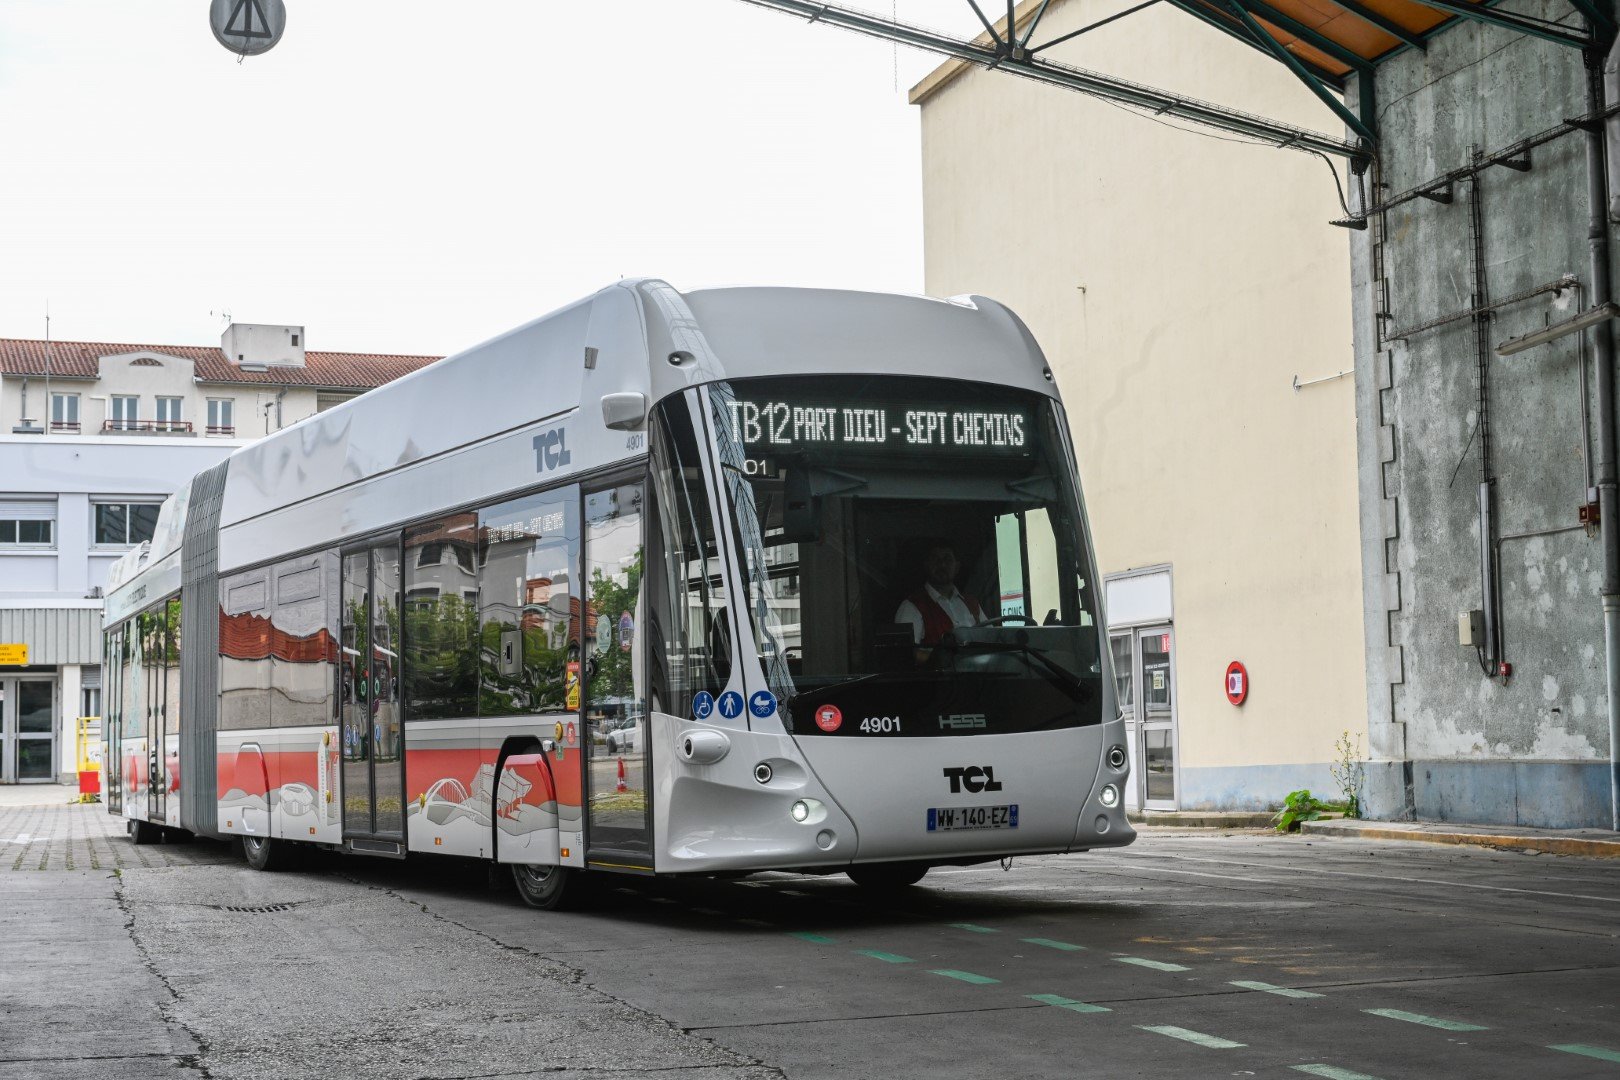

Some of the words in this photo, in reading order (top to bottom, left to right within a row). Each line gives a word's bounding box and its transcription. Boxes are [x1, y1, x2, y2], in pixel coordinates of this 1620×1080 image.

[727, 401, 791, 443] TB12
[793, 407, 836, 441] PART
[843, 409, 885, 442] DIEU
[906, 411, 947, 443] SEPT
[953, 412, 1024, 445] CHEMINS
[532, 427, 571, 474] TCL
[626, 433, 644, 451] 4901
[859, 716, 901, 733] 4901
[938, 713, 987, 729] HESS
[943, 766, 1003, 794] TCL
